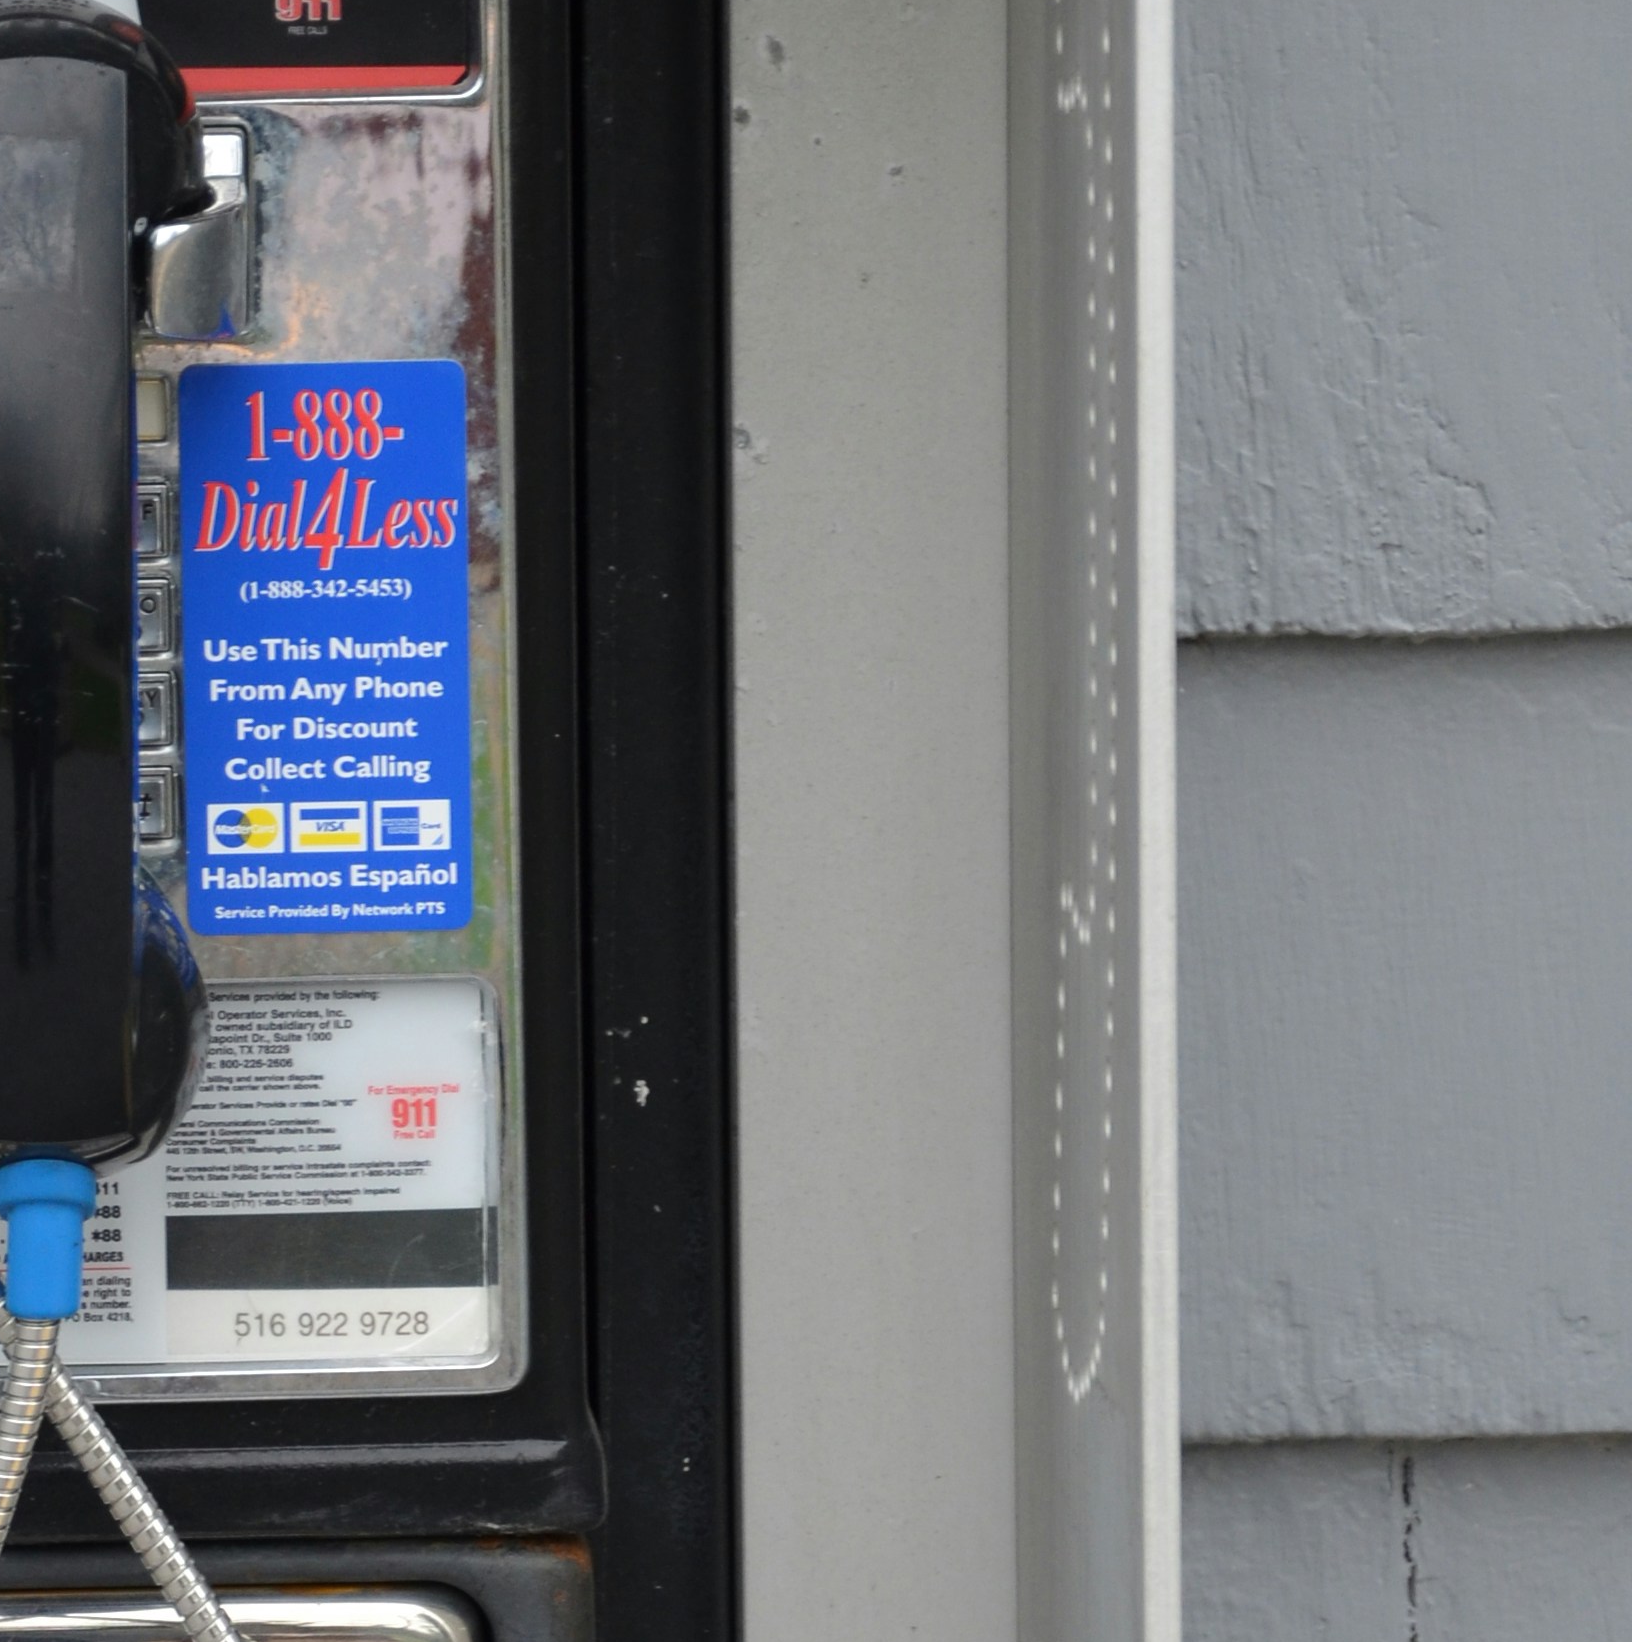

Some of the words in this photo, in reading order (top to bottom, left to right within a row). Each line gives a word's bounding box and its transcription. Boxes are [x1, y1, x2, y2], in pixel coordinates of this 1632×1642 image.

[245, 387, 405, 461] 1-888-
[193, 467, 459, 571] Dial4Less
[239, 578, 413, 604] (1-888-342-5453)
[203, 639, 258, 662] Use
[260, 638, 321, 661] This
[329, 636, 448, 660] Number
[209, 678, 286, 702] From
[290, 677, 347, 706] Any
[355, 676, 444, 699] Phone
[236, 718, 286, 741] For
[293, 717, 418, 740] Discount
[224, 757, 327, 781] Collect
[333, 755, 432, 783] Calling
[315, 821, 345, 832] VISA
[201, 866, 342, 890] Hablamos
[349, 862, 458, 892] Español
[215, 905, 266, 919] Service
[268, 904, 329, 918] Provided
[331, 904, 350, 920] By
[352, 902, 413, 917] Network
[415, 901, 446, 915] PTS
[218, 1009, 267, 1021] Operator
[325, 1007, 346, 1019] Inc.
[367, 1086, 384, 1095] For
[386, 1085, 439, 1097] Emergency
[391, 1098, 437, 1128] 911
[393, 1130, 414, 1139] Free
[416, 1129, 436, 1139] Call
[234, 1313, 286, 1337] 516
[298, 1312, 348, 1337] 922
[360, 1311, 430, 1336] 9728
